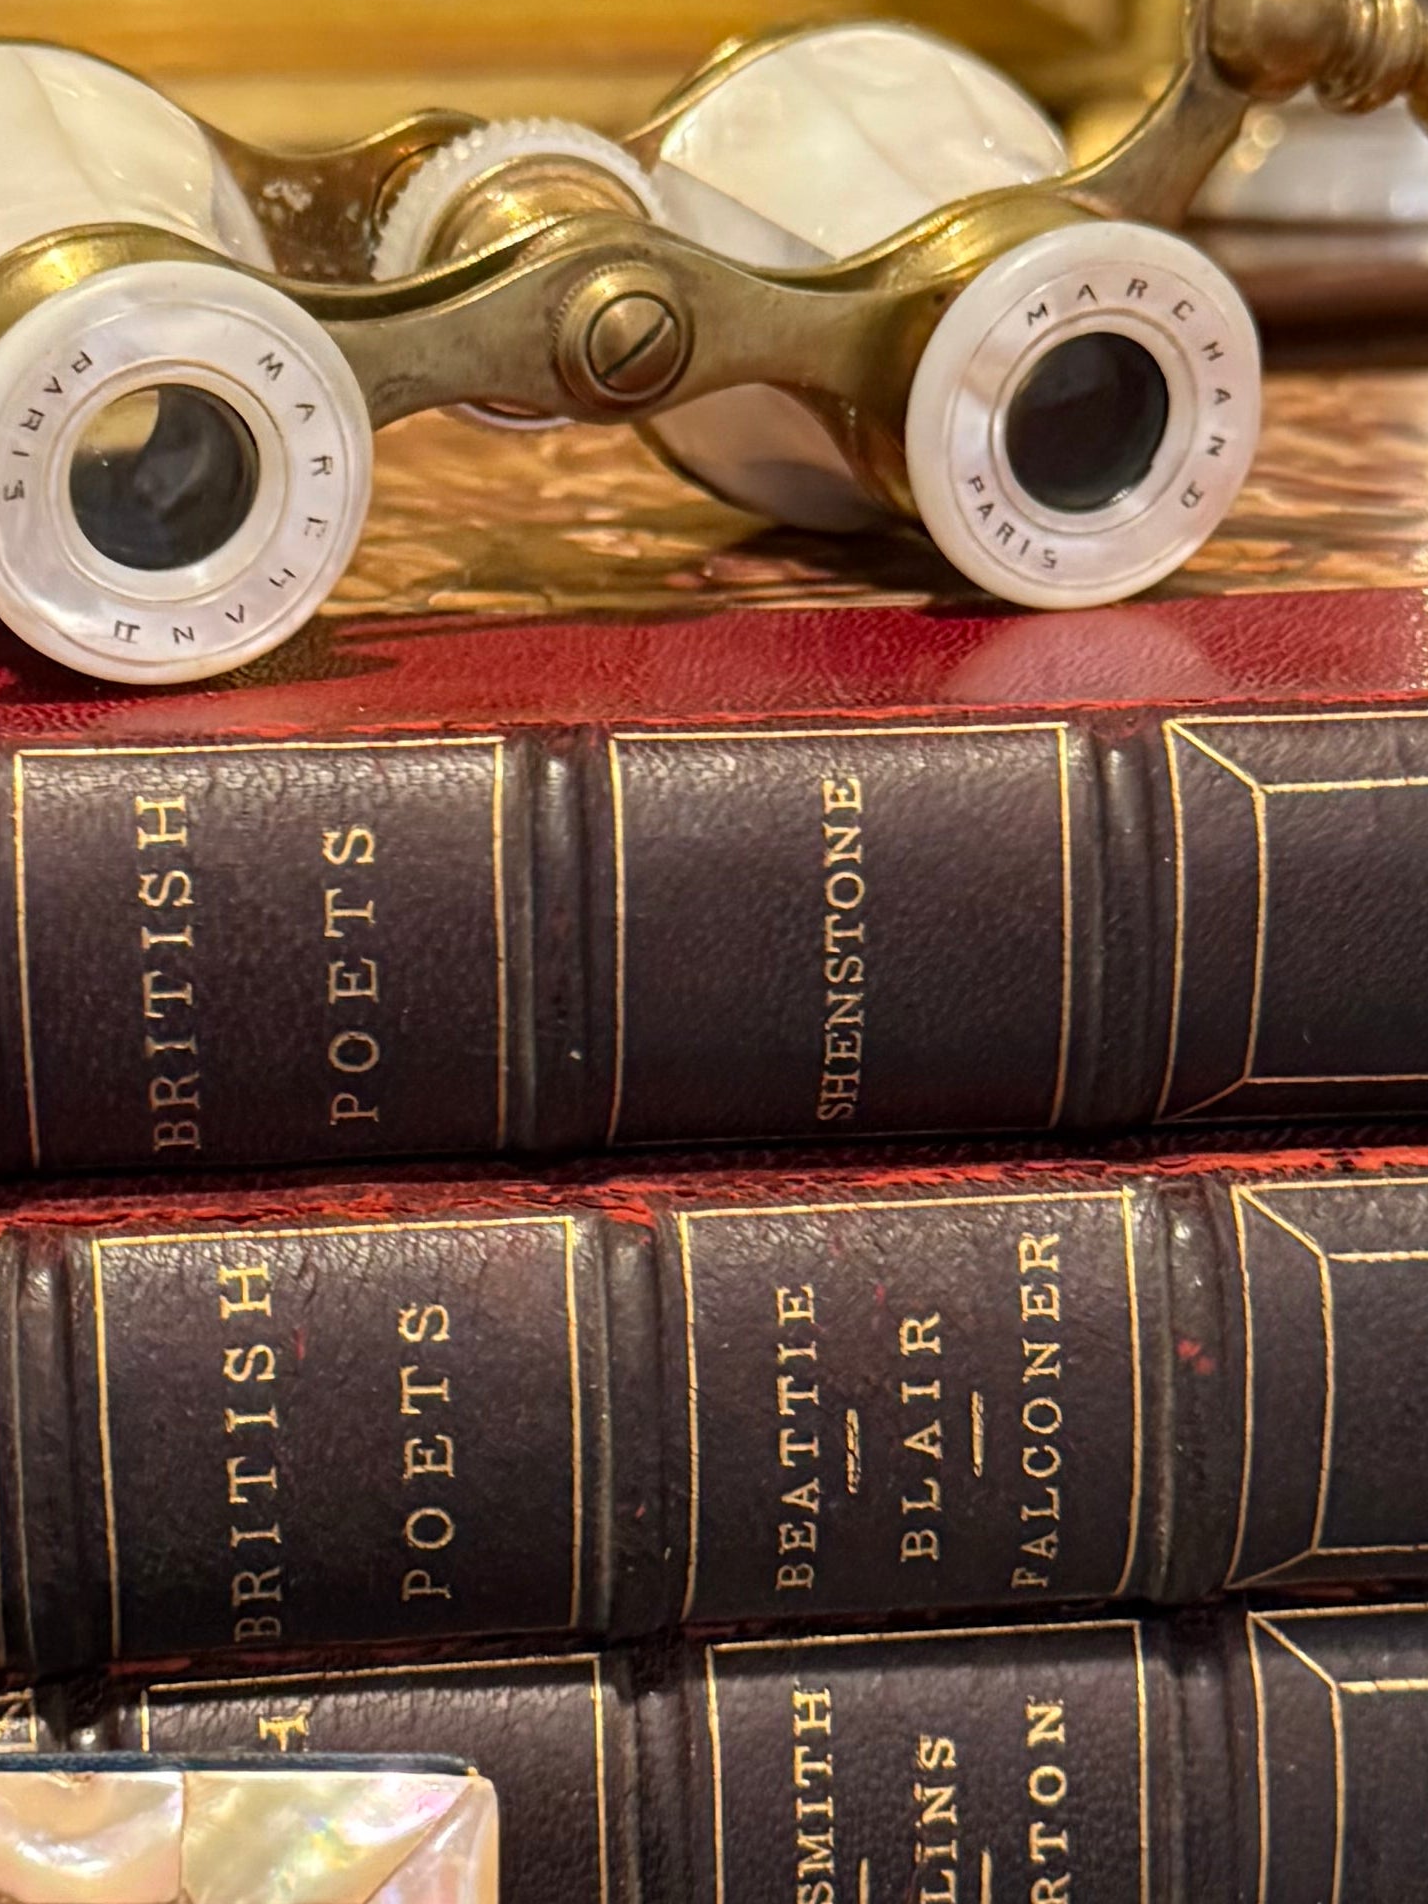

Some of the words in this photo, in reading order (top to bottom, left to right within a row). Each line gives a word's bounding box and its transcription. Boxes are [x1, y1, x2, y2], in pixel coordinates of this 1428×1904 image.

[4, 351, 94, 502] PARIS
[968, 476, 1058, 570] PARIS
[1027, 278, 1231, 510] MARCHAND
[135, 794, 202, 1152] BRITISH
[324, 824, 380, 1125] POETS
[818, 776, 865, 1121] SHENSTONE
[220, 1259, 284, 1642] BRITISH
[399, 1302, 456, 1601] POETS
[777, 1283, 819, 1591] BEATTIE
[900, 1312, 943, 1562] BLAIR
[1012, 1232, 1062, 1590] FALCONER
